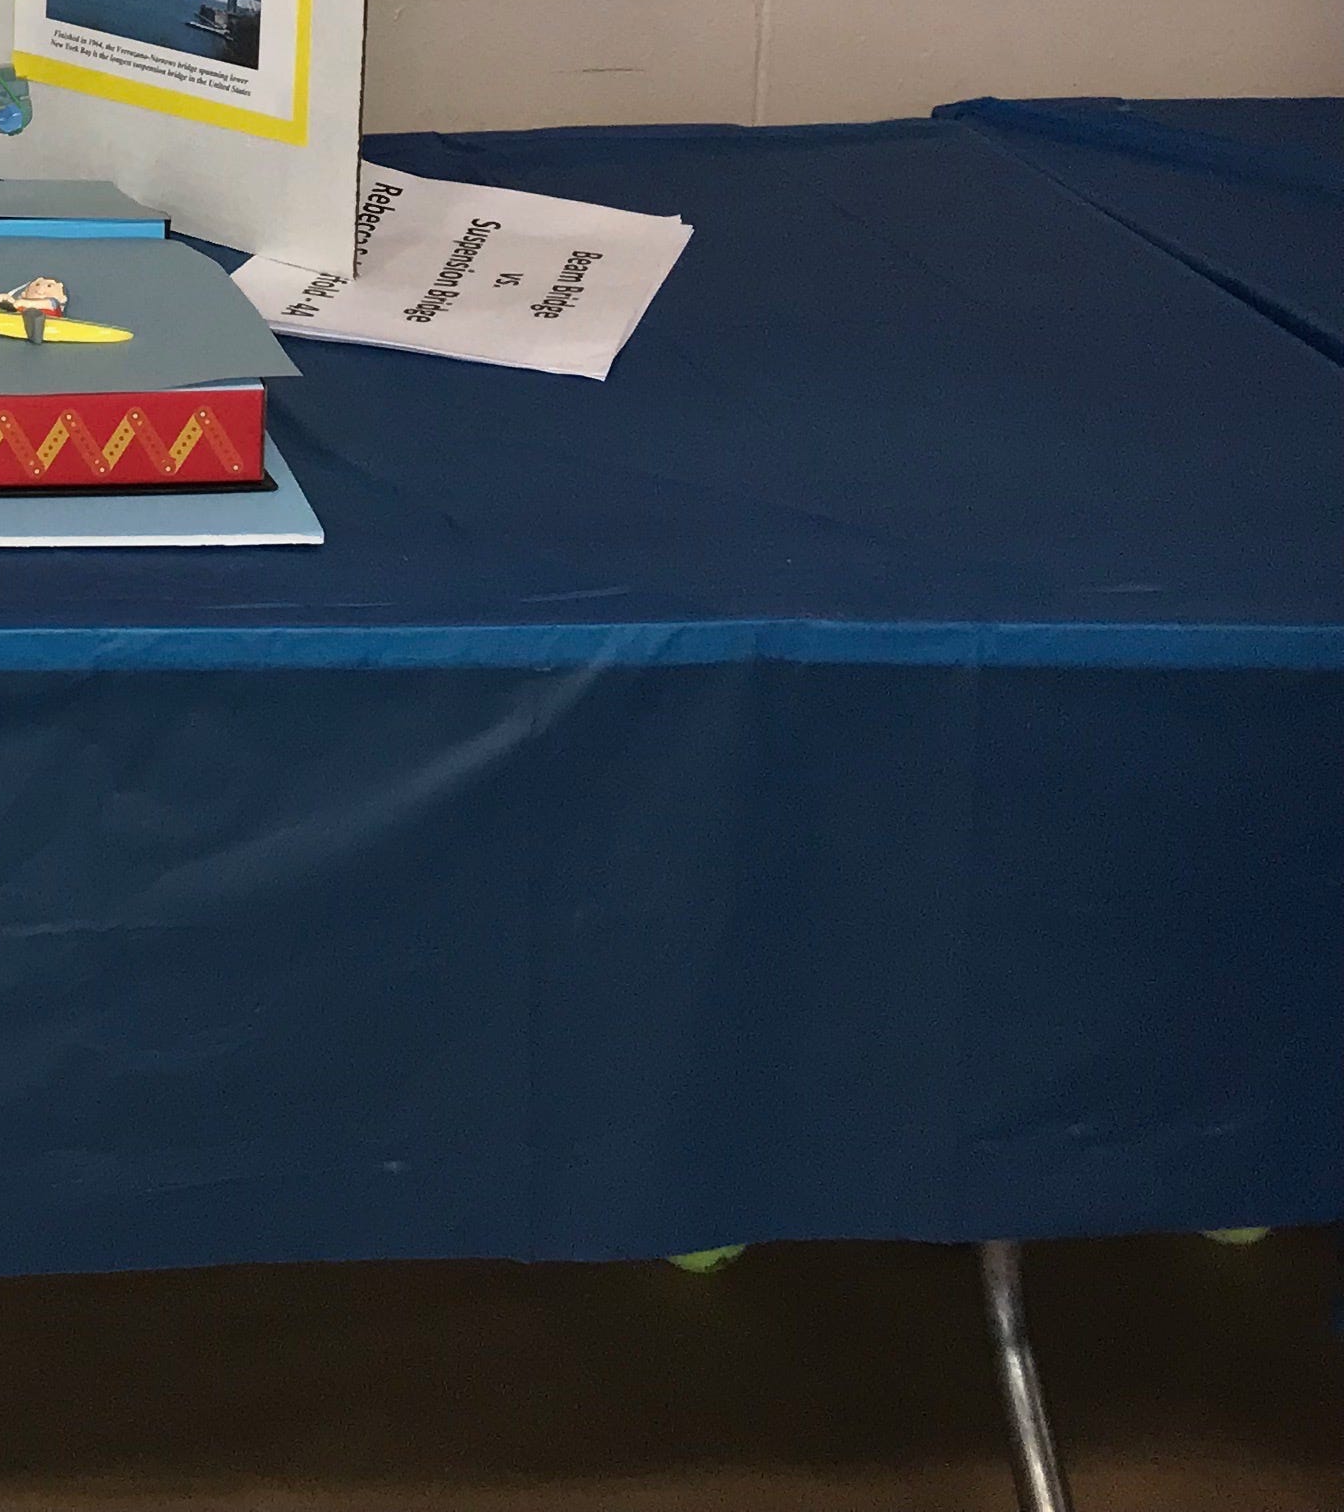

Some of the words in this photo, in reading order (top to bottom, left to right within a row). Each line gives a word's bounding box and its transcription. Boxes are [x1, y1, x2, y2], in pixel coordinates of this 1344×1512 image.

[434, 218, 501, 286] Suspension
[558, 250, 603, 283] Beam
[494, 272, 524, 288] vs.
[281, 302, 319, 318] 4A
[404, 289, 460, 322] Bridge
[530, 285, 584, 318] Bridge
